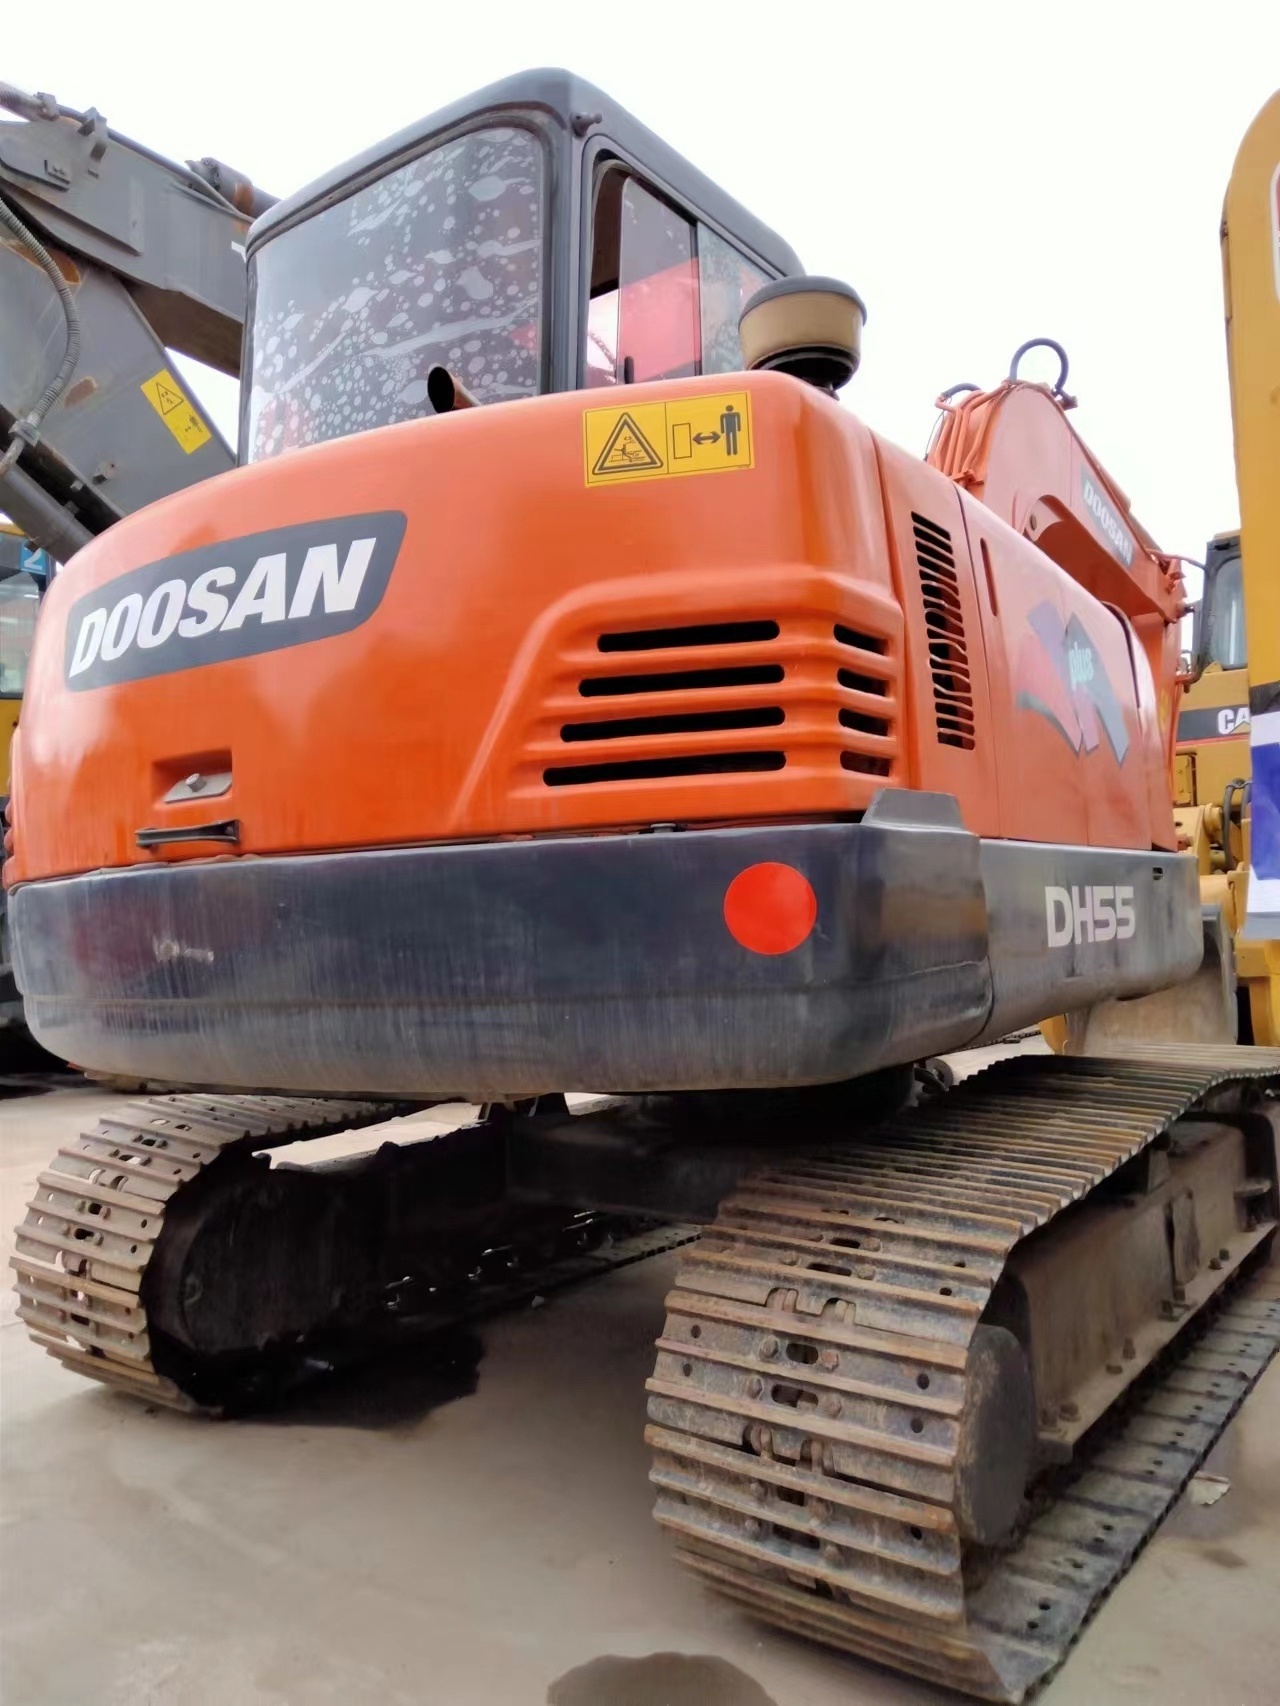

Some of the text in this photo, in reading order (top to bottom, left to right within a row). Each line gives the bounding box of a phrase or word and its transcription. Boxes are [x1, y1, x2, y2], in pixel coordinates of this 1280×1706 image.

[1083, 480, 1133, 565] DOOSAN
[69, 538, 376, 678] DOOSAN
[1045, 885, 1136, 948] DH55
